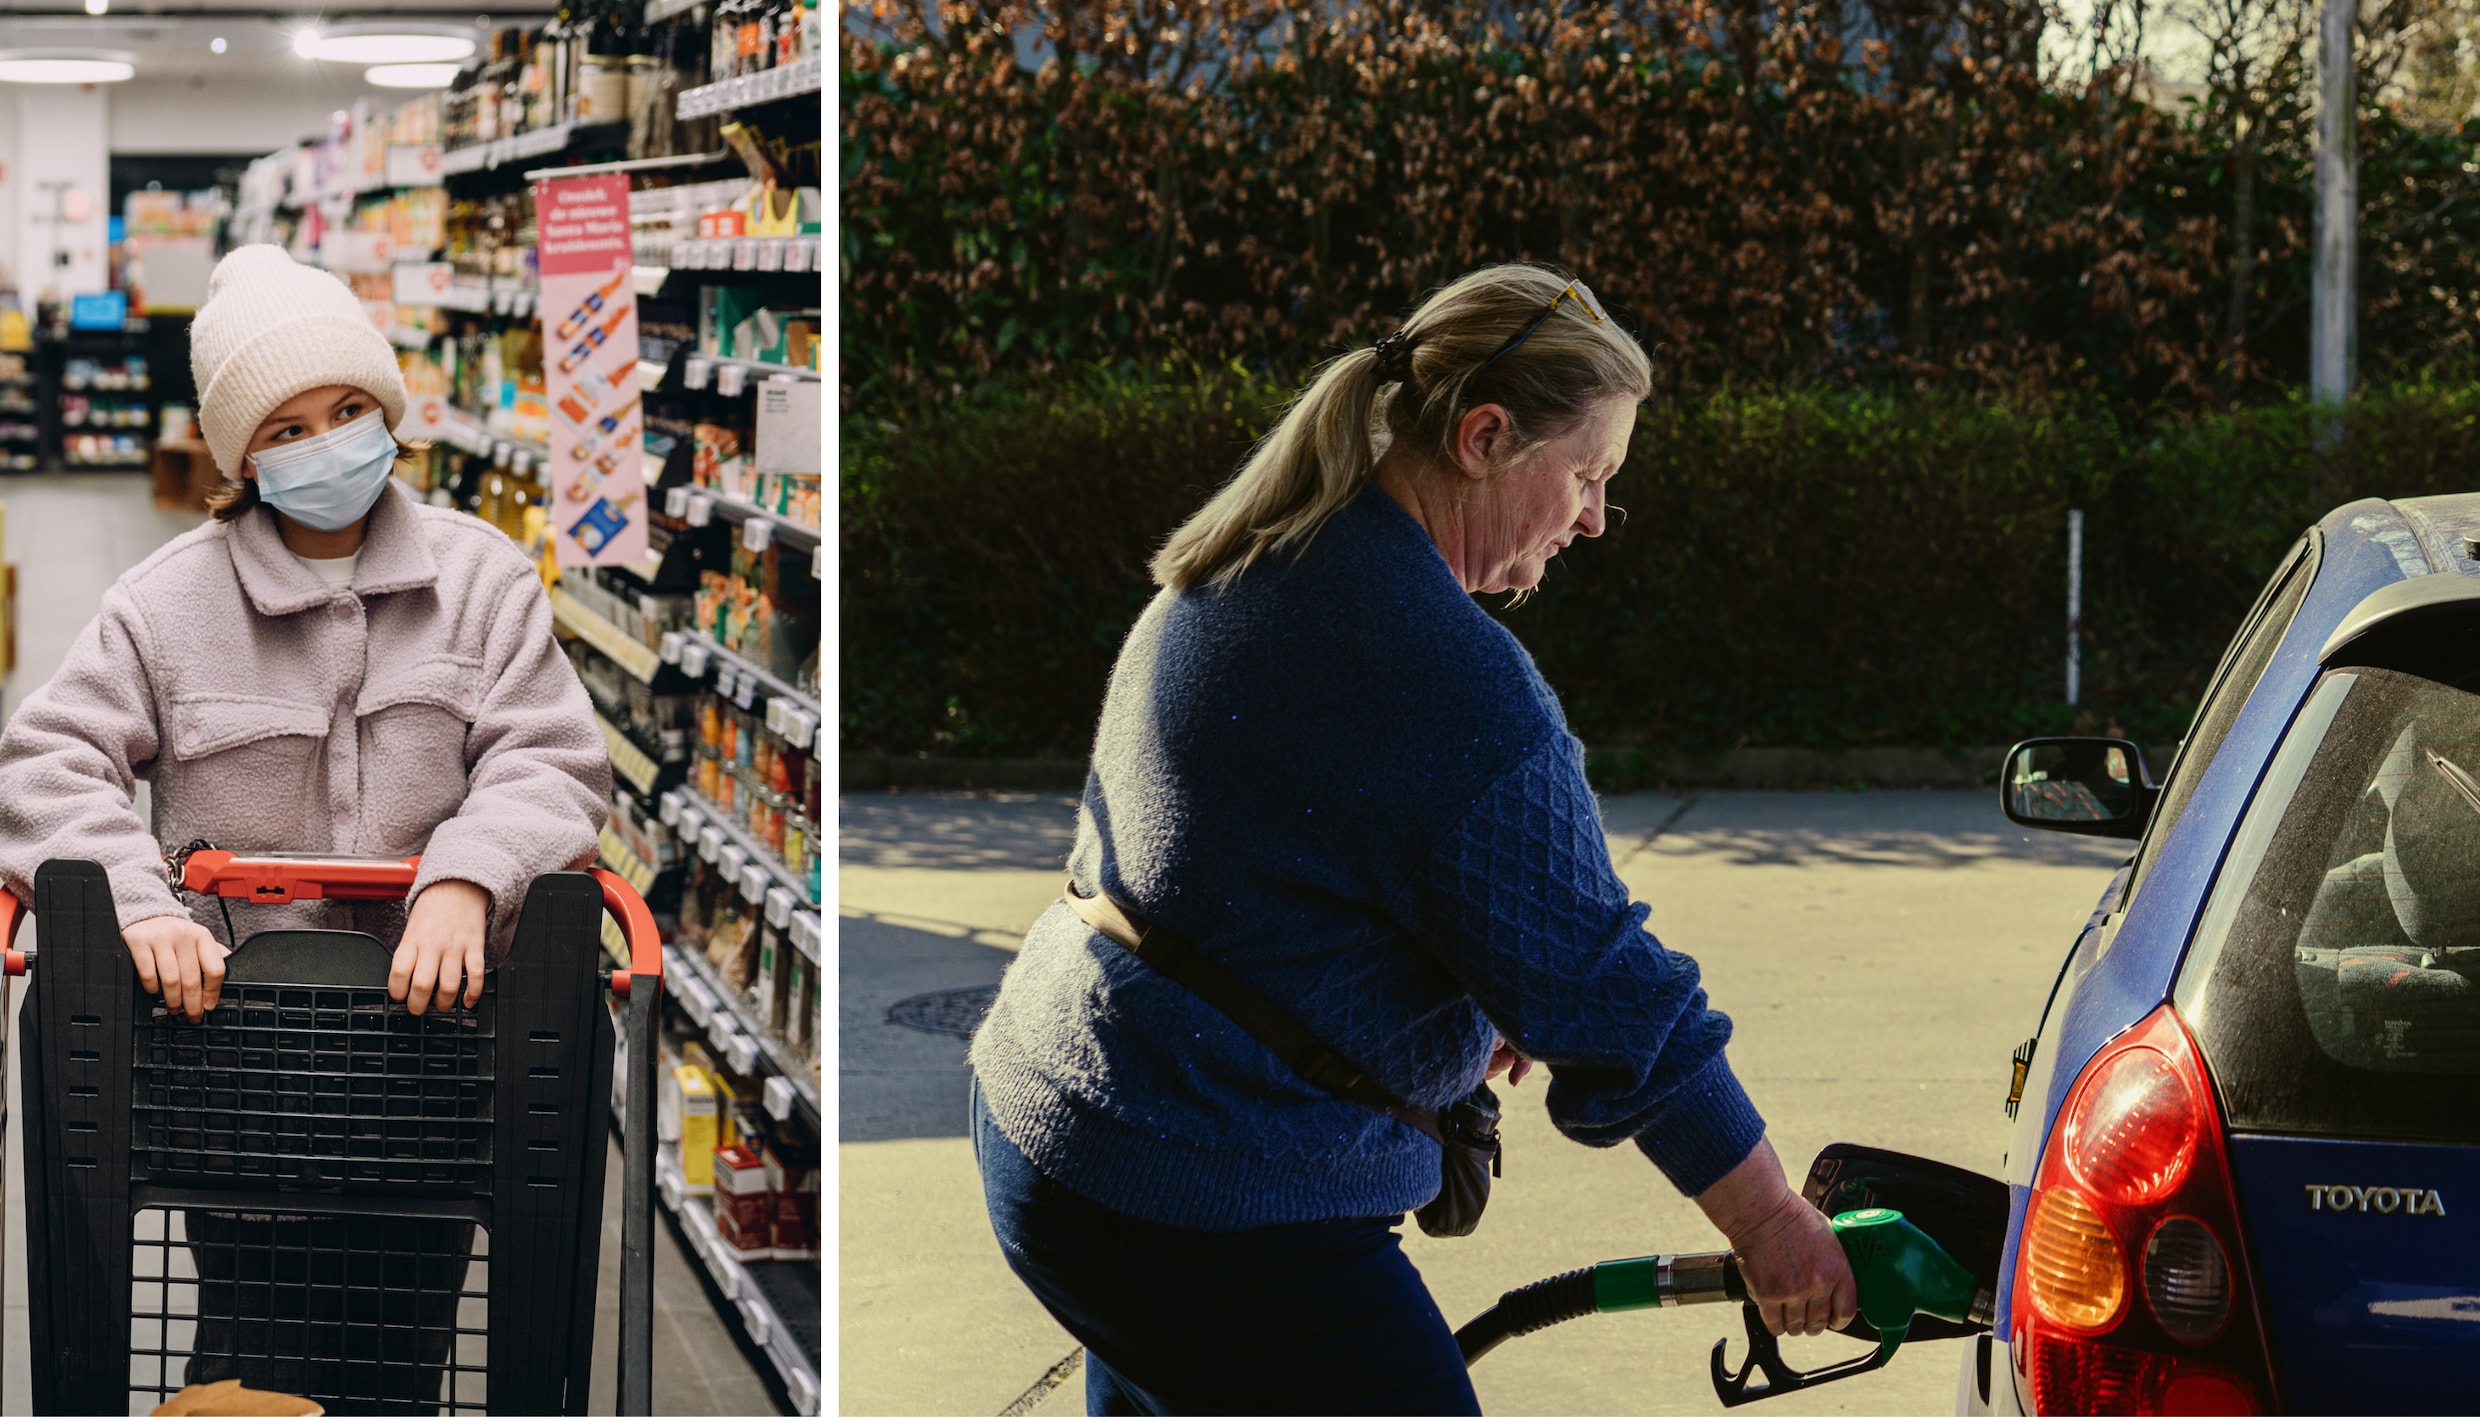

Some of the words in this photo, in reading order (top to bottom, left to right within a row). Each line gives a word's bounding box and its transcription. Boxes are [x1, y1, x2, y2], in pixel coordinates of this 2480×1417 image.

[558, 188, 608, 203] Ontdek
[549, 206, 566, 221] de
[569, 205, 618, 219] nieuwe
[546, 223, 583, 237] Santa
[585, 219, 624, 234] Maria
[2305, 1184, 2446, 1217] TOYOTA
